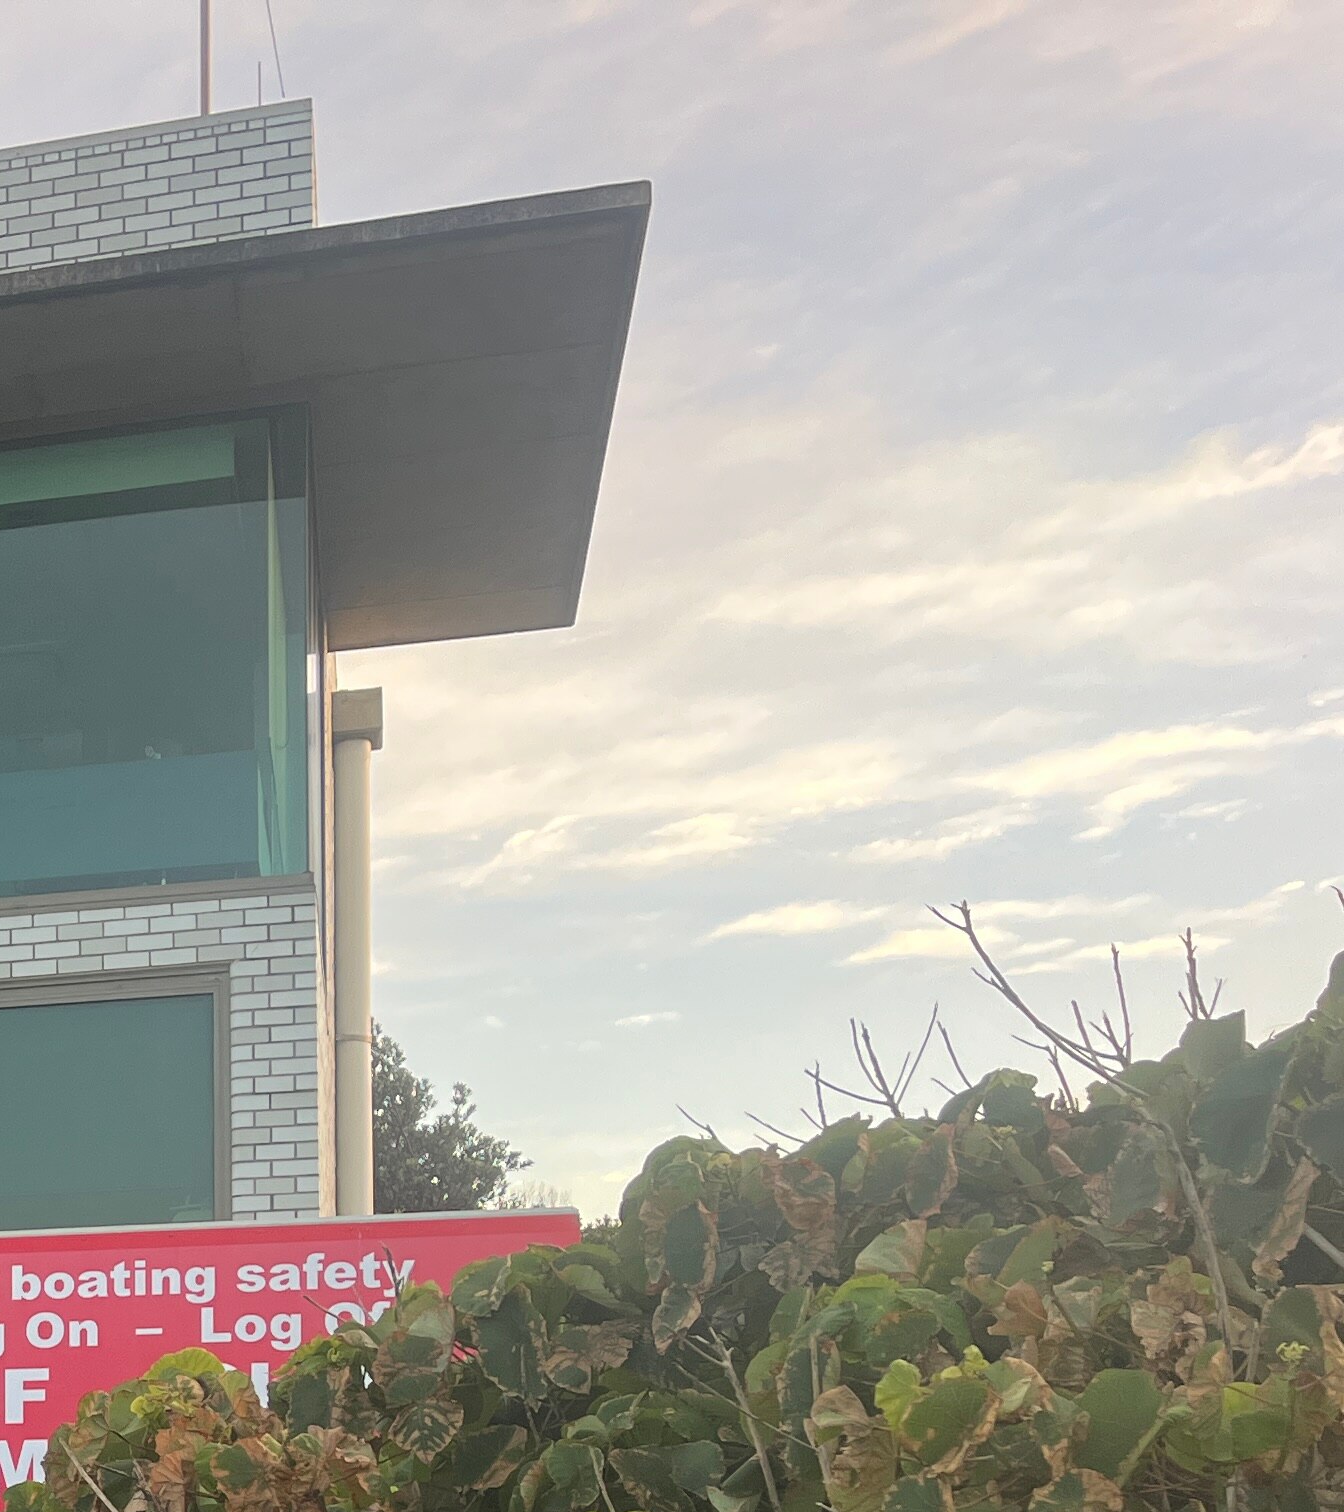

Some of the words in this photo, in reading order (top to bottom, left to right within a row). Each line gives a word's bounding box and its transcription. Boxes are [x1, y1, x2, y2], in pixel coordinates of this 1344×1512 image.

[11, 1259, 216, 1304] boating
[235, 1251, 415, 1298] safety
[25, 1311, 99, 1349] On
[200, 1306, 303, 1351] Log
